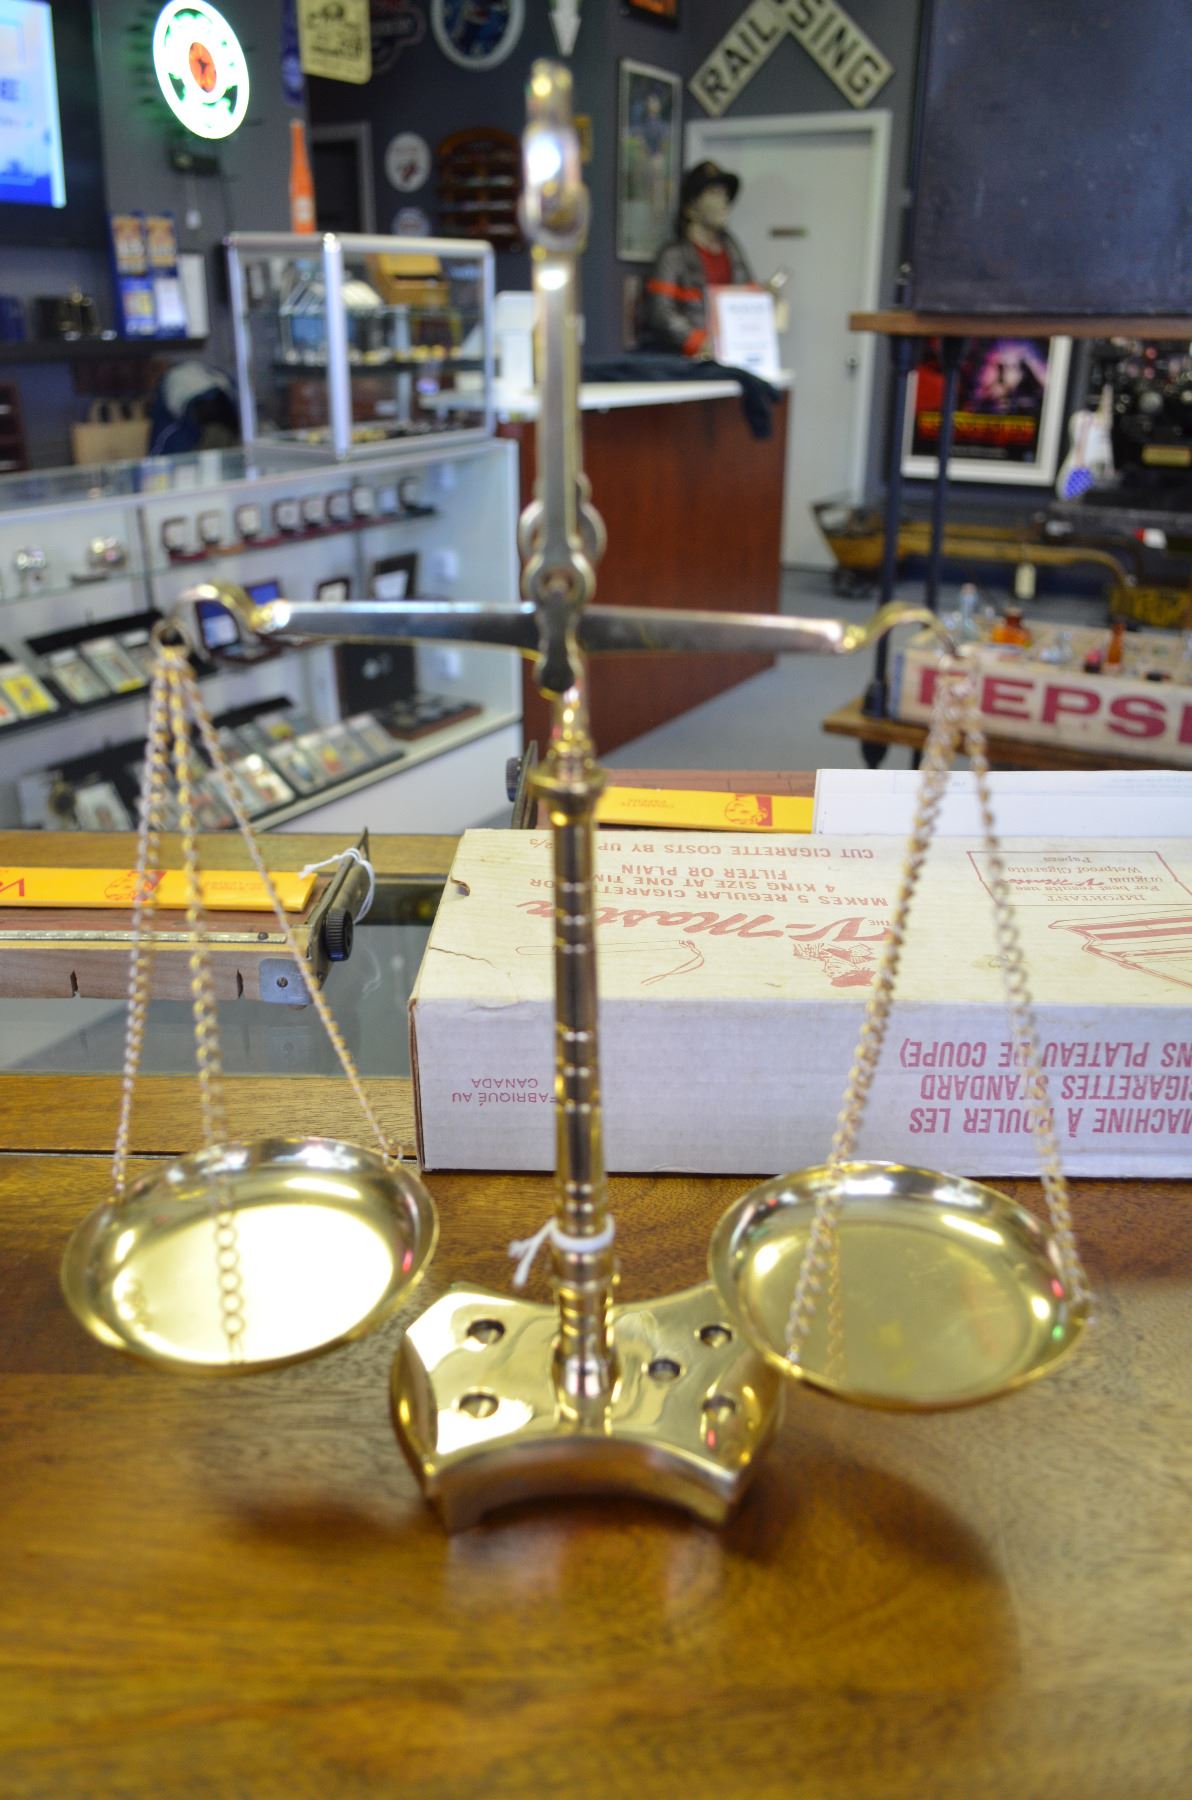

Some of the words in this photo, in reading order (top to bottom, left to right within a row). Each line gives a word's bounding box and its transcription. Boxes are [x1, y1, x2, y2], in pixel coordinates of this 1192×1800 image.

[701, 15, 779, 104] RAIL
[597, 842, 622, 852] UP
[631, 843, 655, 854] BY
[663, 843, 722, 855] COSTS
[729, 845, 831, 859] CIGARETTE
[839, 848, 874, 860] CUT
[621, 864, 678, 876] PLAIN
[688, 866, 714, 878] OR
[722, 867, 788, 881] FILTER
[592, 873, 625, 884] TI
[632, 876, 674, 886] ONE
[683, 878, 705, 888] AT
[714, 879, 757, 890] SIZE
[592, 885, 686, 898] CIGARET
[766, 881, 816, 892] KING
[824, 883, 836, 893] 4
[696, 890, 788, 903] REGULAR
[797, 894, 809, 904] 5
[817, 895, 889, 907] MAKES
[515, 900, 892, 943] V-Mastr
[868, 919, 890, 927] THE
[898, 1037, 987, 1069] COUPE)
[1041, 1041, 1150, 1069] PLATEAU
[471, 1078, 538, 1089] CANADA
[1060, 1074, 1192, 1102] IGARETTES
[451, 1092, 473, 1103] AU
[908, 1107, 952, 1134] LES
